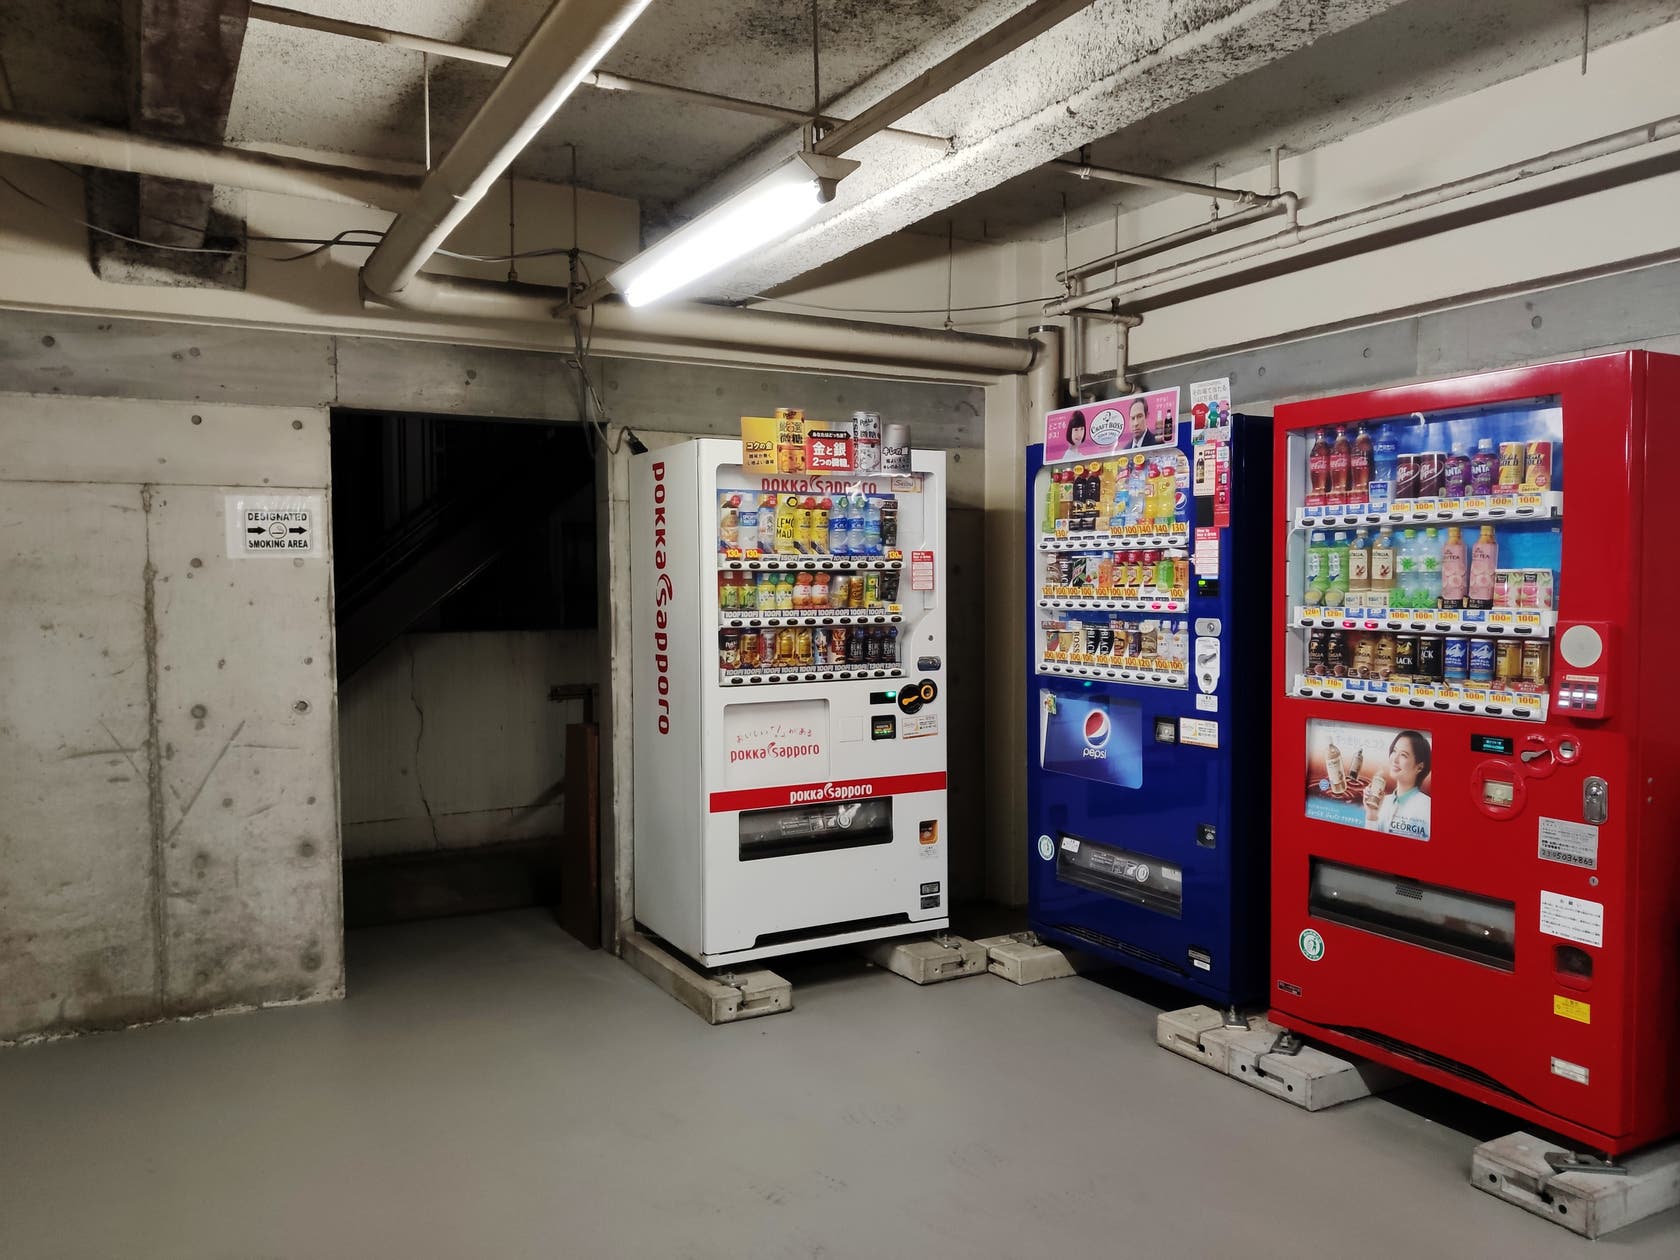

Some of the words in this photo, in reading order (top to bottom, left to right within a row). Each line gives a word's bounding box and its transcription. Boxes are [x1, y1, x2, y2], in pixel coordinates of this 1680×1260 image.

[812, 441, 847, 457] 金と銀
[247, 512, 307, 521] DESIGNATED
[652, 461, 667, 569] pokka
[248, 540, 285, 548] SMOKING
[287, 540, 308, 548] AREA
[655, 573, 673, 735] sapporo
[730, 748, 767, 763] pokka
[769, 743, 820, 758] sapporo
[1082, 747, 1107, 760] pepsi
[789, 791, 824, 804] pokka
[826, 784, 873, 799] sapporo
[1390, 821, 1426, 835] GEORGIA
